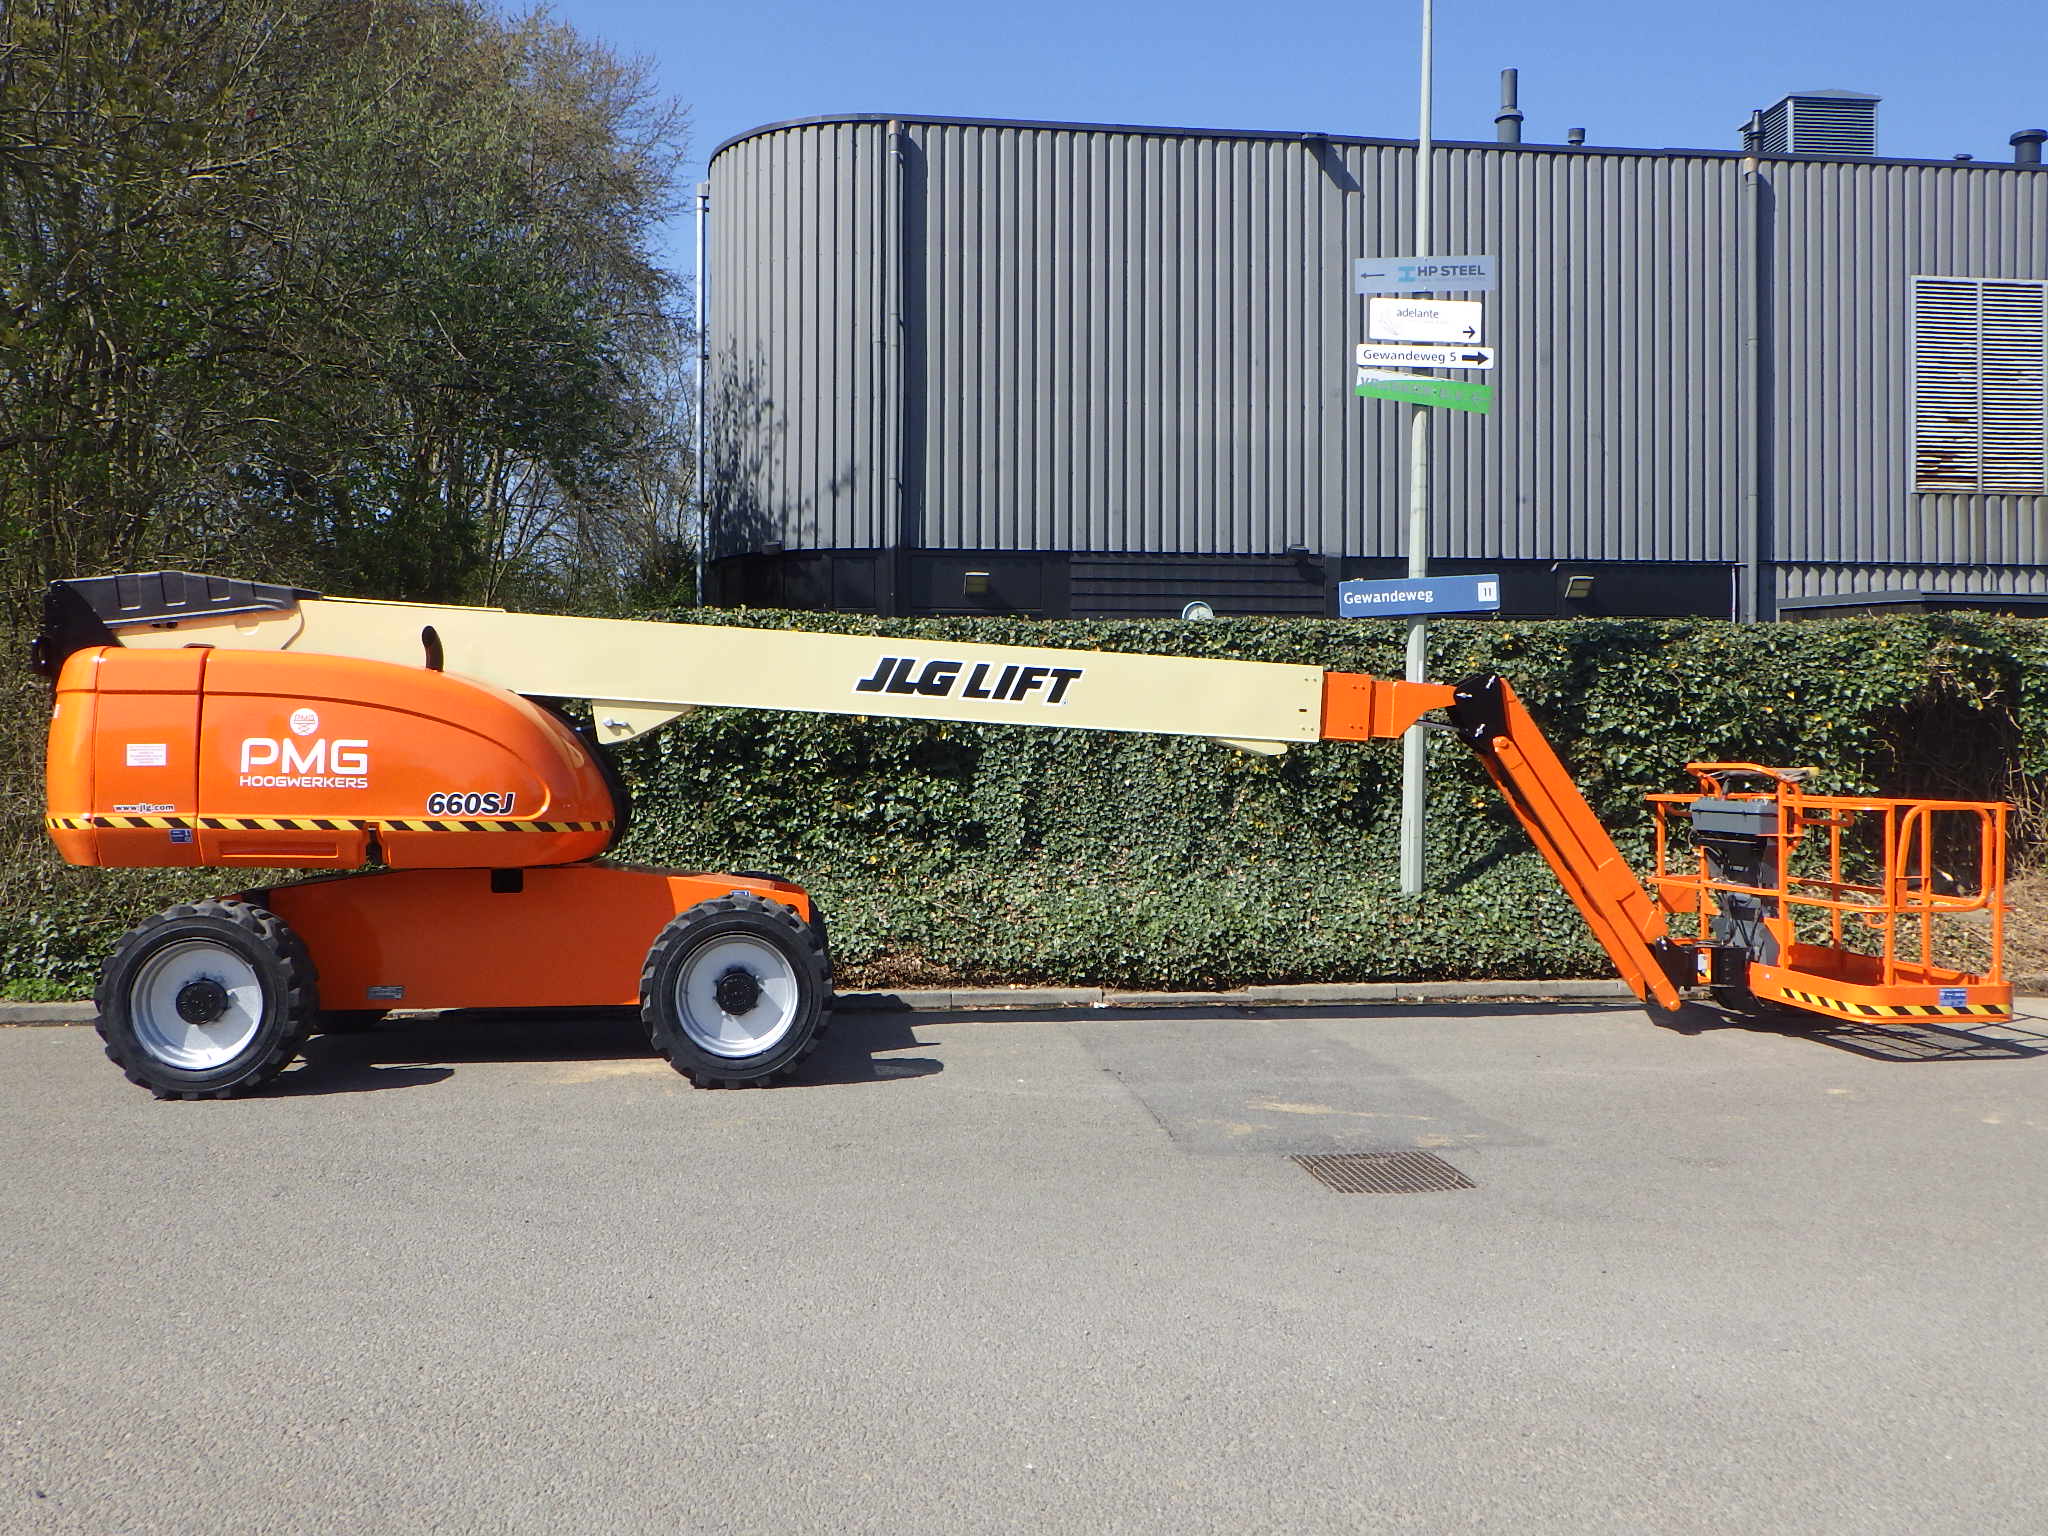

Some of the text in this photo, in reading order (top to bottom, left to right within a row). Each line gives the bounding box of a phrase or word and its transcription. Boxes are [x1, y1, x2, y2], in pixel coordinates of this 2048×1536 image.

[1417, 265, 1486, 276] HP STEEL
[1396, 307, 1439, 318] adelante
[1363, 350, 1457, 363] Gewandeweg 5
[1343, 590, 1433, 604] Gewandeweg
[855, 657, 1083, 703] JLG LIFT
[240, 737, 369, 775] PMG
[239, 776, 369, 789] HOOGWERKERS
[115, 803, 174, 813] www.jlg.com
[427, 793, 515, 815] 660SJ
